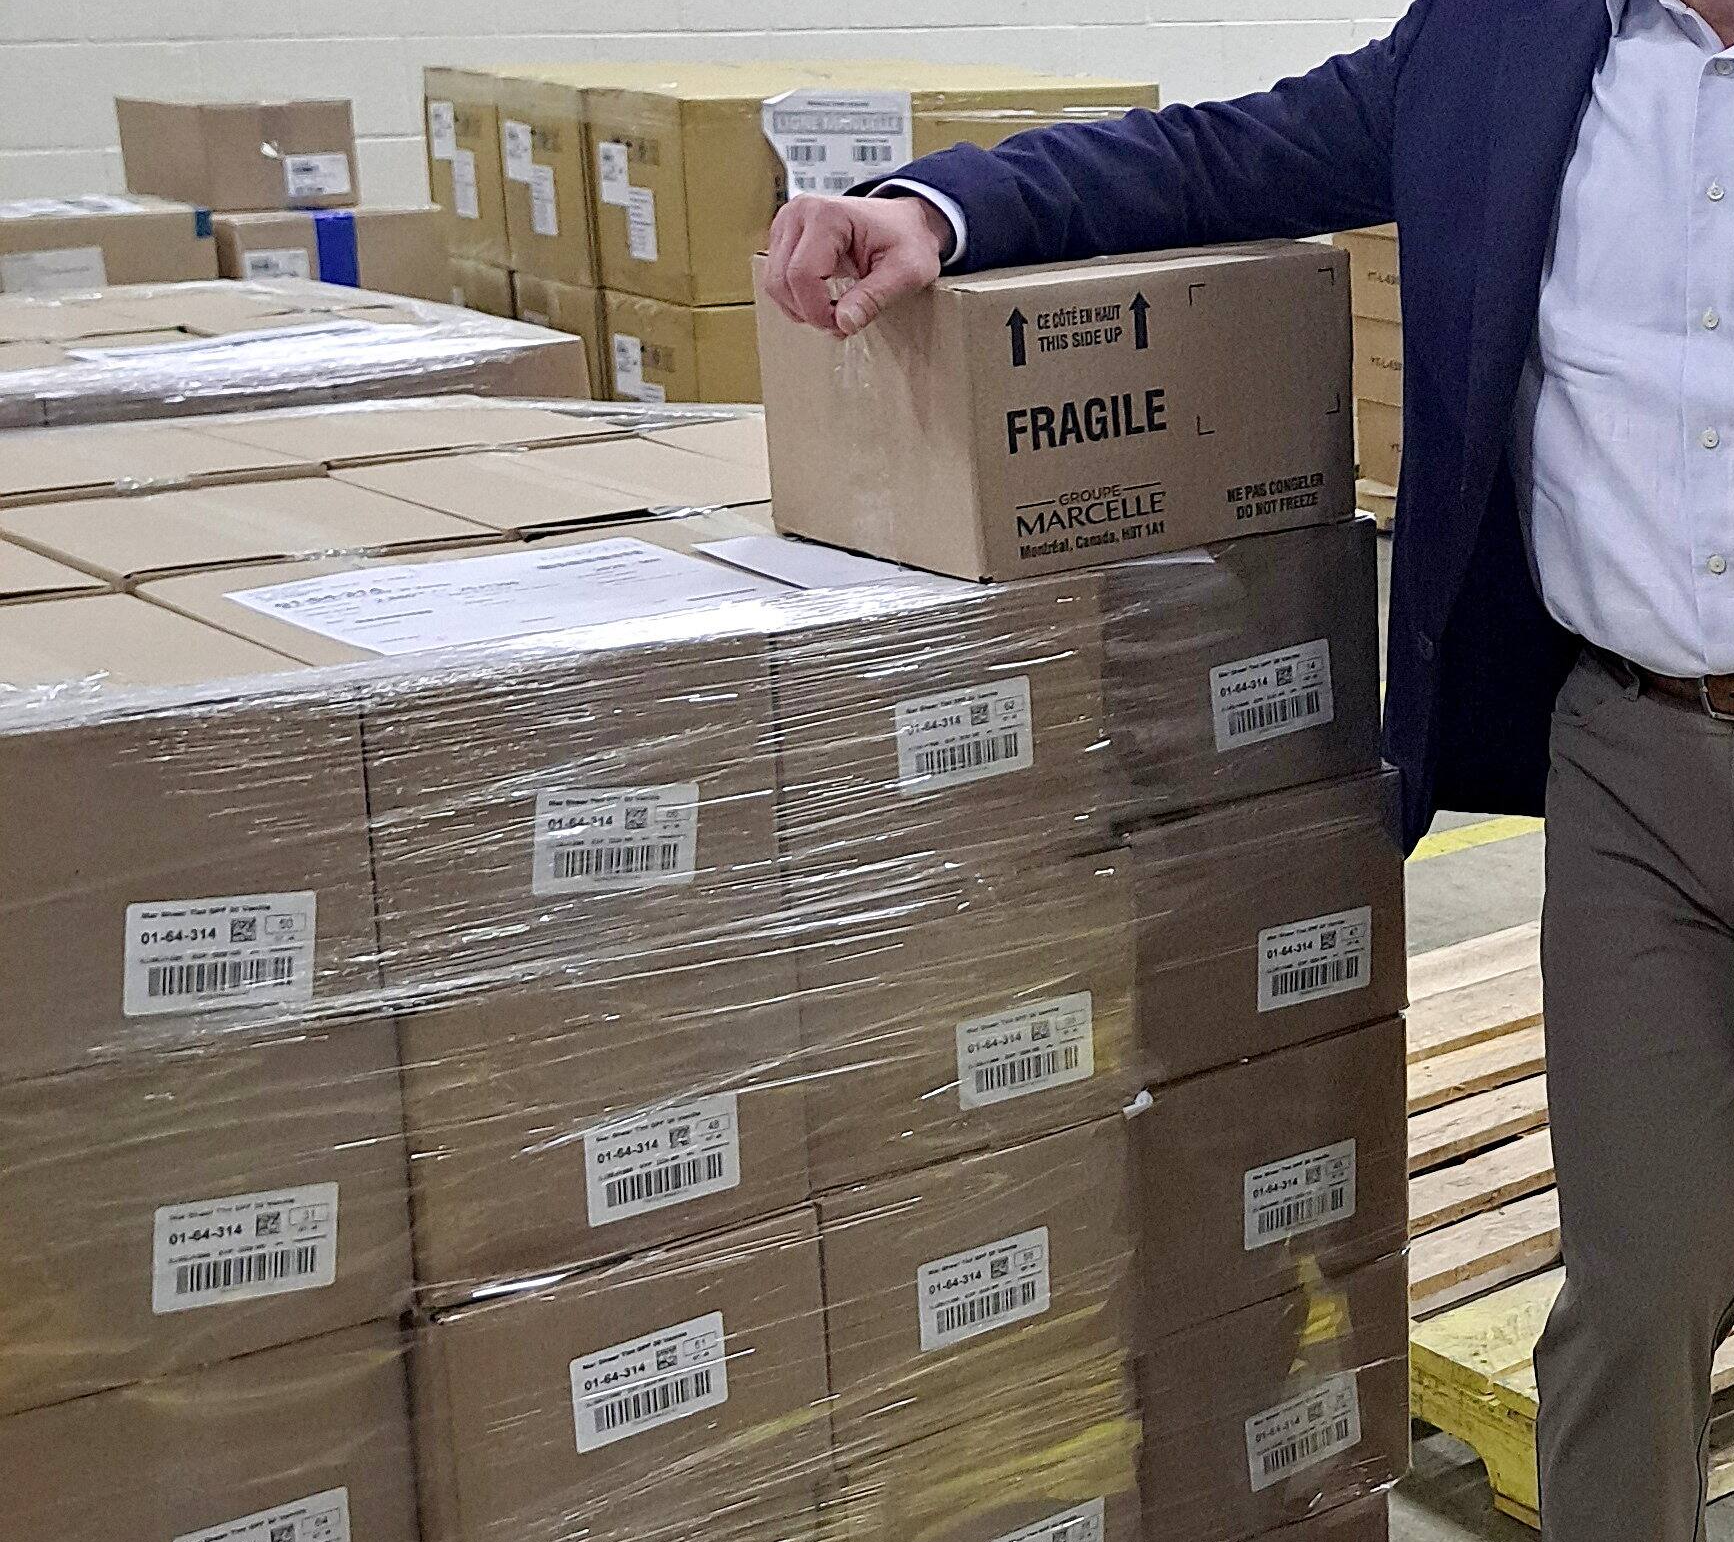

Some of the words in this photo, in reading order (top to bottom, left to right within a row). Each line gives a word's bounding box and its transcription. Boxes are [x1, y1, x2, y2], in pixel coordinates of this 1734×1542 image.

[1080, 307, 1093, 325] EN
[1094, 304, 1121, 321] HAUT
[1038, 333, 1069, 352] THIS
[1072, 329, 1102, 348] SIDE
[1104, 326, 1123, 344] UP
[1006, 388, 1168, 455] FRAGILE
[1058, 484, 1122, 506] GROUPE
[1244, 482, 1267, 500] PAS
[1016, 491, 1167, 538] MARCELLE
[1236, 503, 1253, 520] DO
[1255, 499, 1279, 516] NOT
[1279, 491, 1319, 512] FREEZE
[141, 927, 216, 945] 01-64-314
[597, 1138, 659, 1164] 01-64-314
[168, 1223, 243, 1245] 01-64-314
[928, 1269, 982, 1295] 01-64-314
[584, 1362, 646, 1391] 01-64-314
